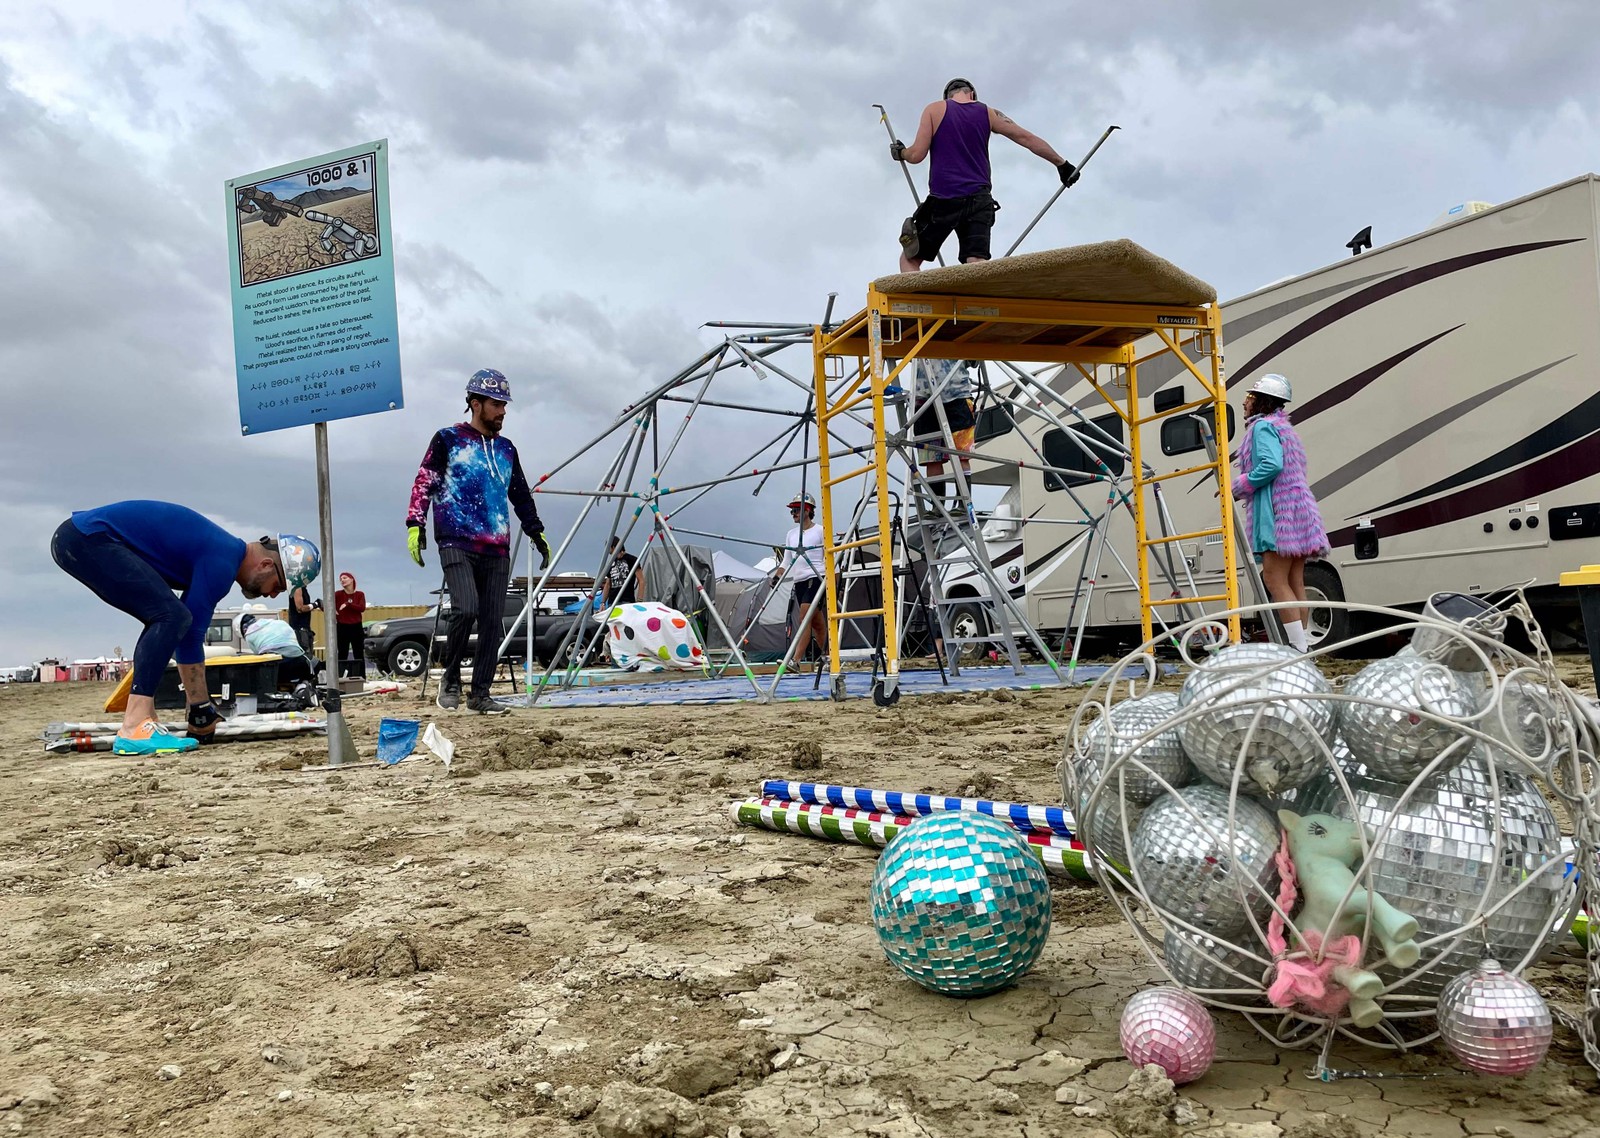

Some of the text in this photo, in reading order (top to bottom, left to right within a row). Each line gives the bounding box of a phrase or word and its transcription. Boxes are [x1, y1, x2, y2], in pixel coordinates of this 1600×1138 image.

[307, 160, 367, 186] 1000 & 1
[252, 300, 272, 309] wood's
[301, 287, 330, 298] consumed
[257, 291, 272, 299] Metal
[274, 287, 288, 295] stood
[325, 275, 345, 283] circuits
[253, 315, 276, 326] Reduced
[327, 301, 351, 310] embrace
[265, 306, 284, 314] ancient
[1159, 316, 1197, 324] METALTECH
[265, 340, 285, 349] Wood's
[316, 331, 336, 339] flames
[255, 360, 278, 369] progress
[297, 352, 312, 360] could
[324, 347, 339, 355] make
[258, 351, 274, 359] Metal
[275, 347, 297, 355] realized
